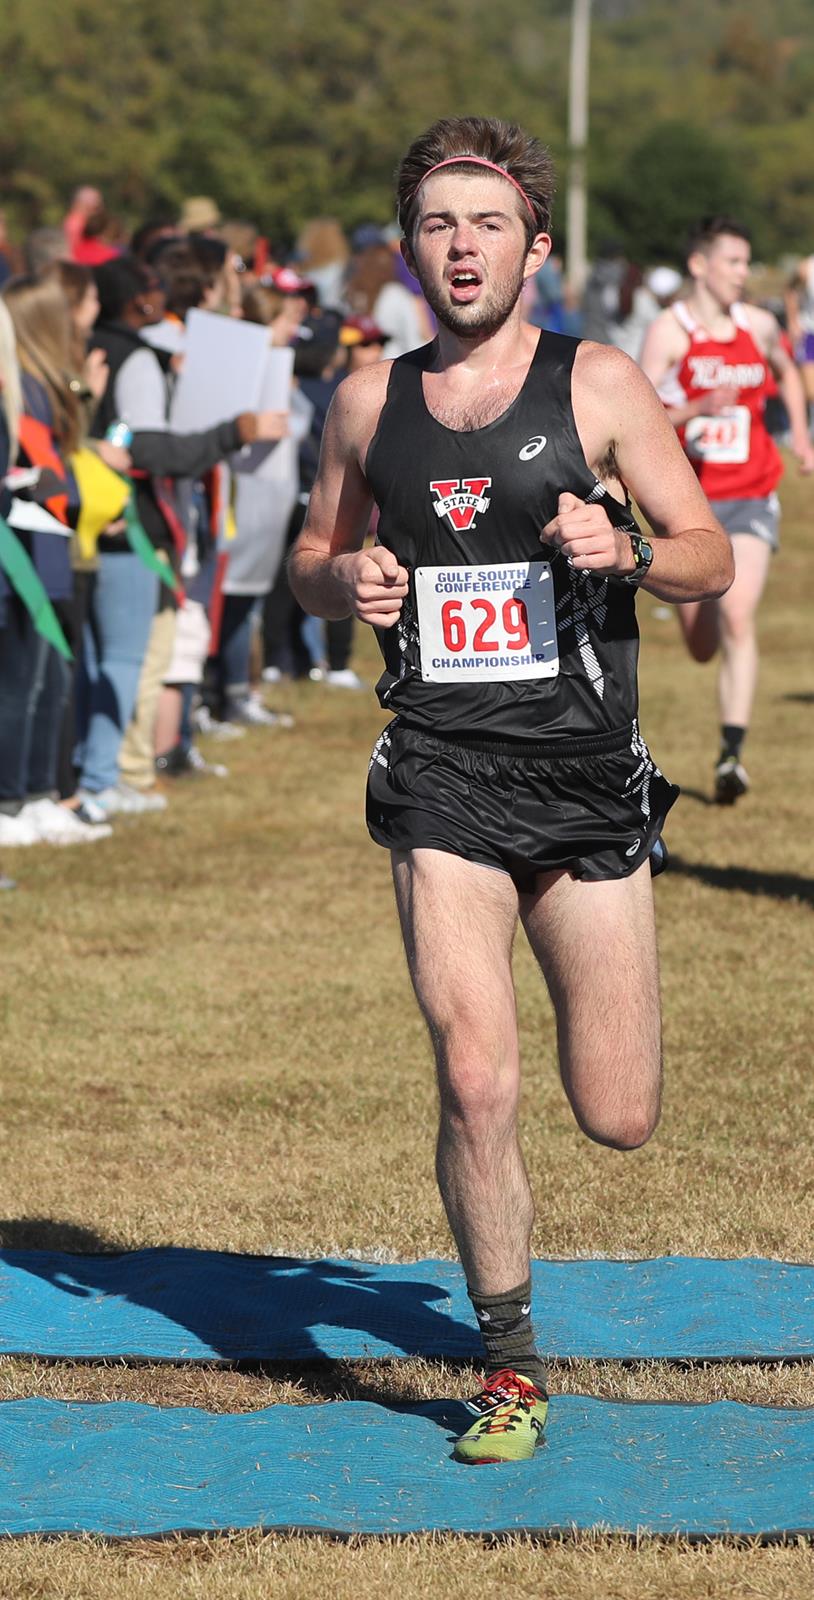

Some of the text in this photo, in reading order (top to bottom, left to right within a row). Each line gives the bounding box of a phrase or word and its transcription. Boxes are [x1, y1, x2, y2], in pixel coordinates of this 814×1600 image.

[443, 496, 479, 509] STATE
[437, 569, 526, 583] GULF SOUTH
[435, 579, 531, 593] CONFERENCE
[441, 598, 529, 652] 629
[432, 653, 545, 668] CHAMPIONSHIP
